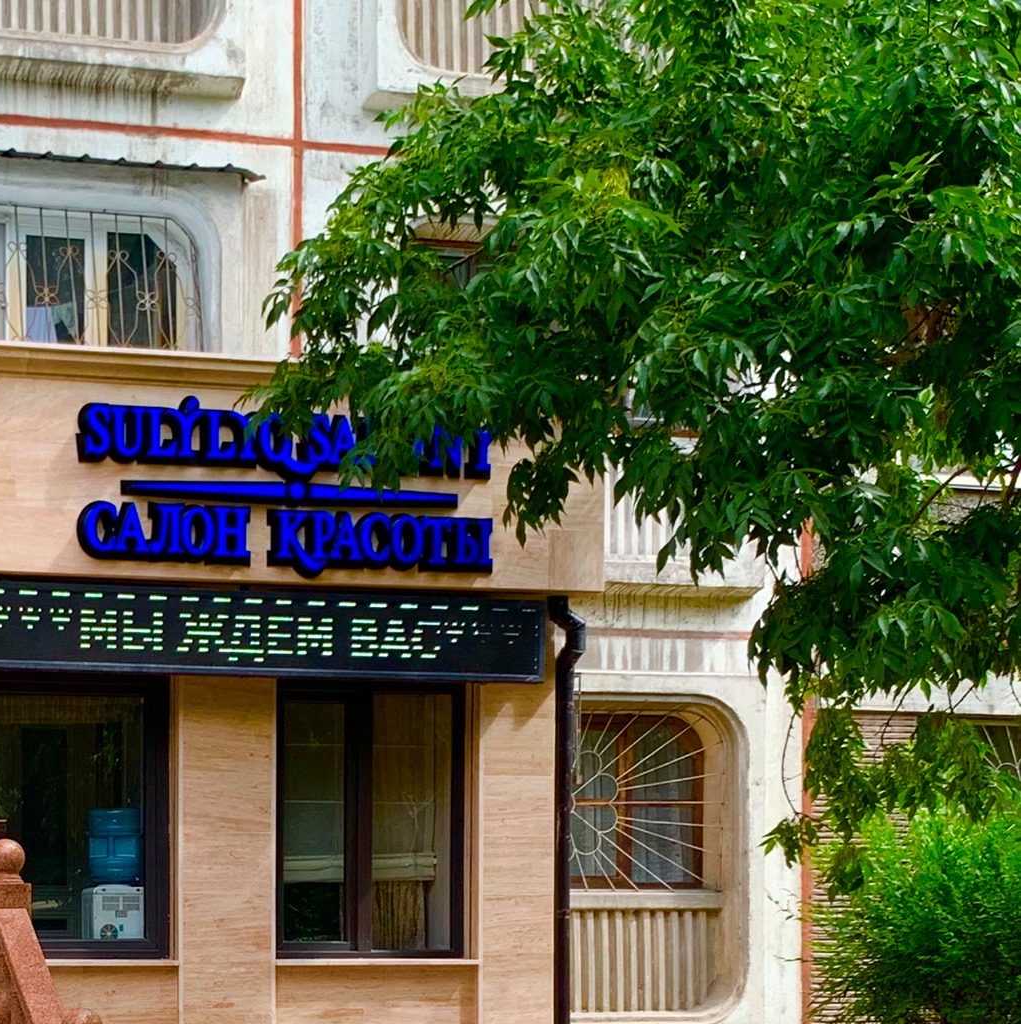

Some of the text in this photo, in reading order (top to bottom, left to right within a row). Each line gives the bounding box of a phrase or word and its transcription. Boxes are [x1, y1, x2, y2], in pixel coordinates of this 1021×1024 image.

[306, 411, 494, 478] SANY
[79, 502, 493, 577] САЛОН КРАСОТЫ
[80, 610, 441, 663] МЫ ЖДЕМ ВАС
